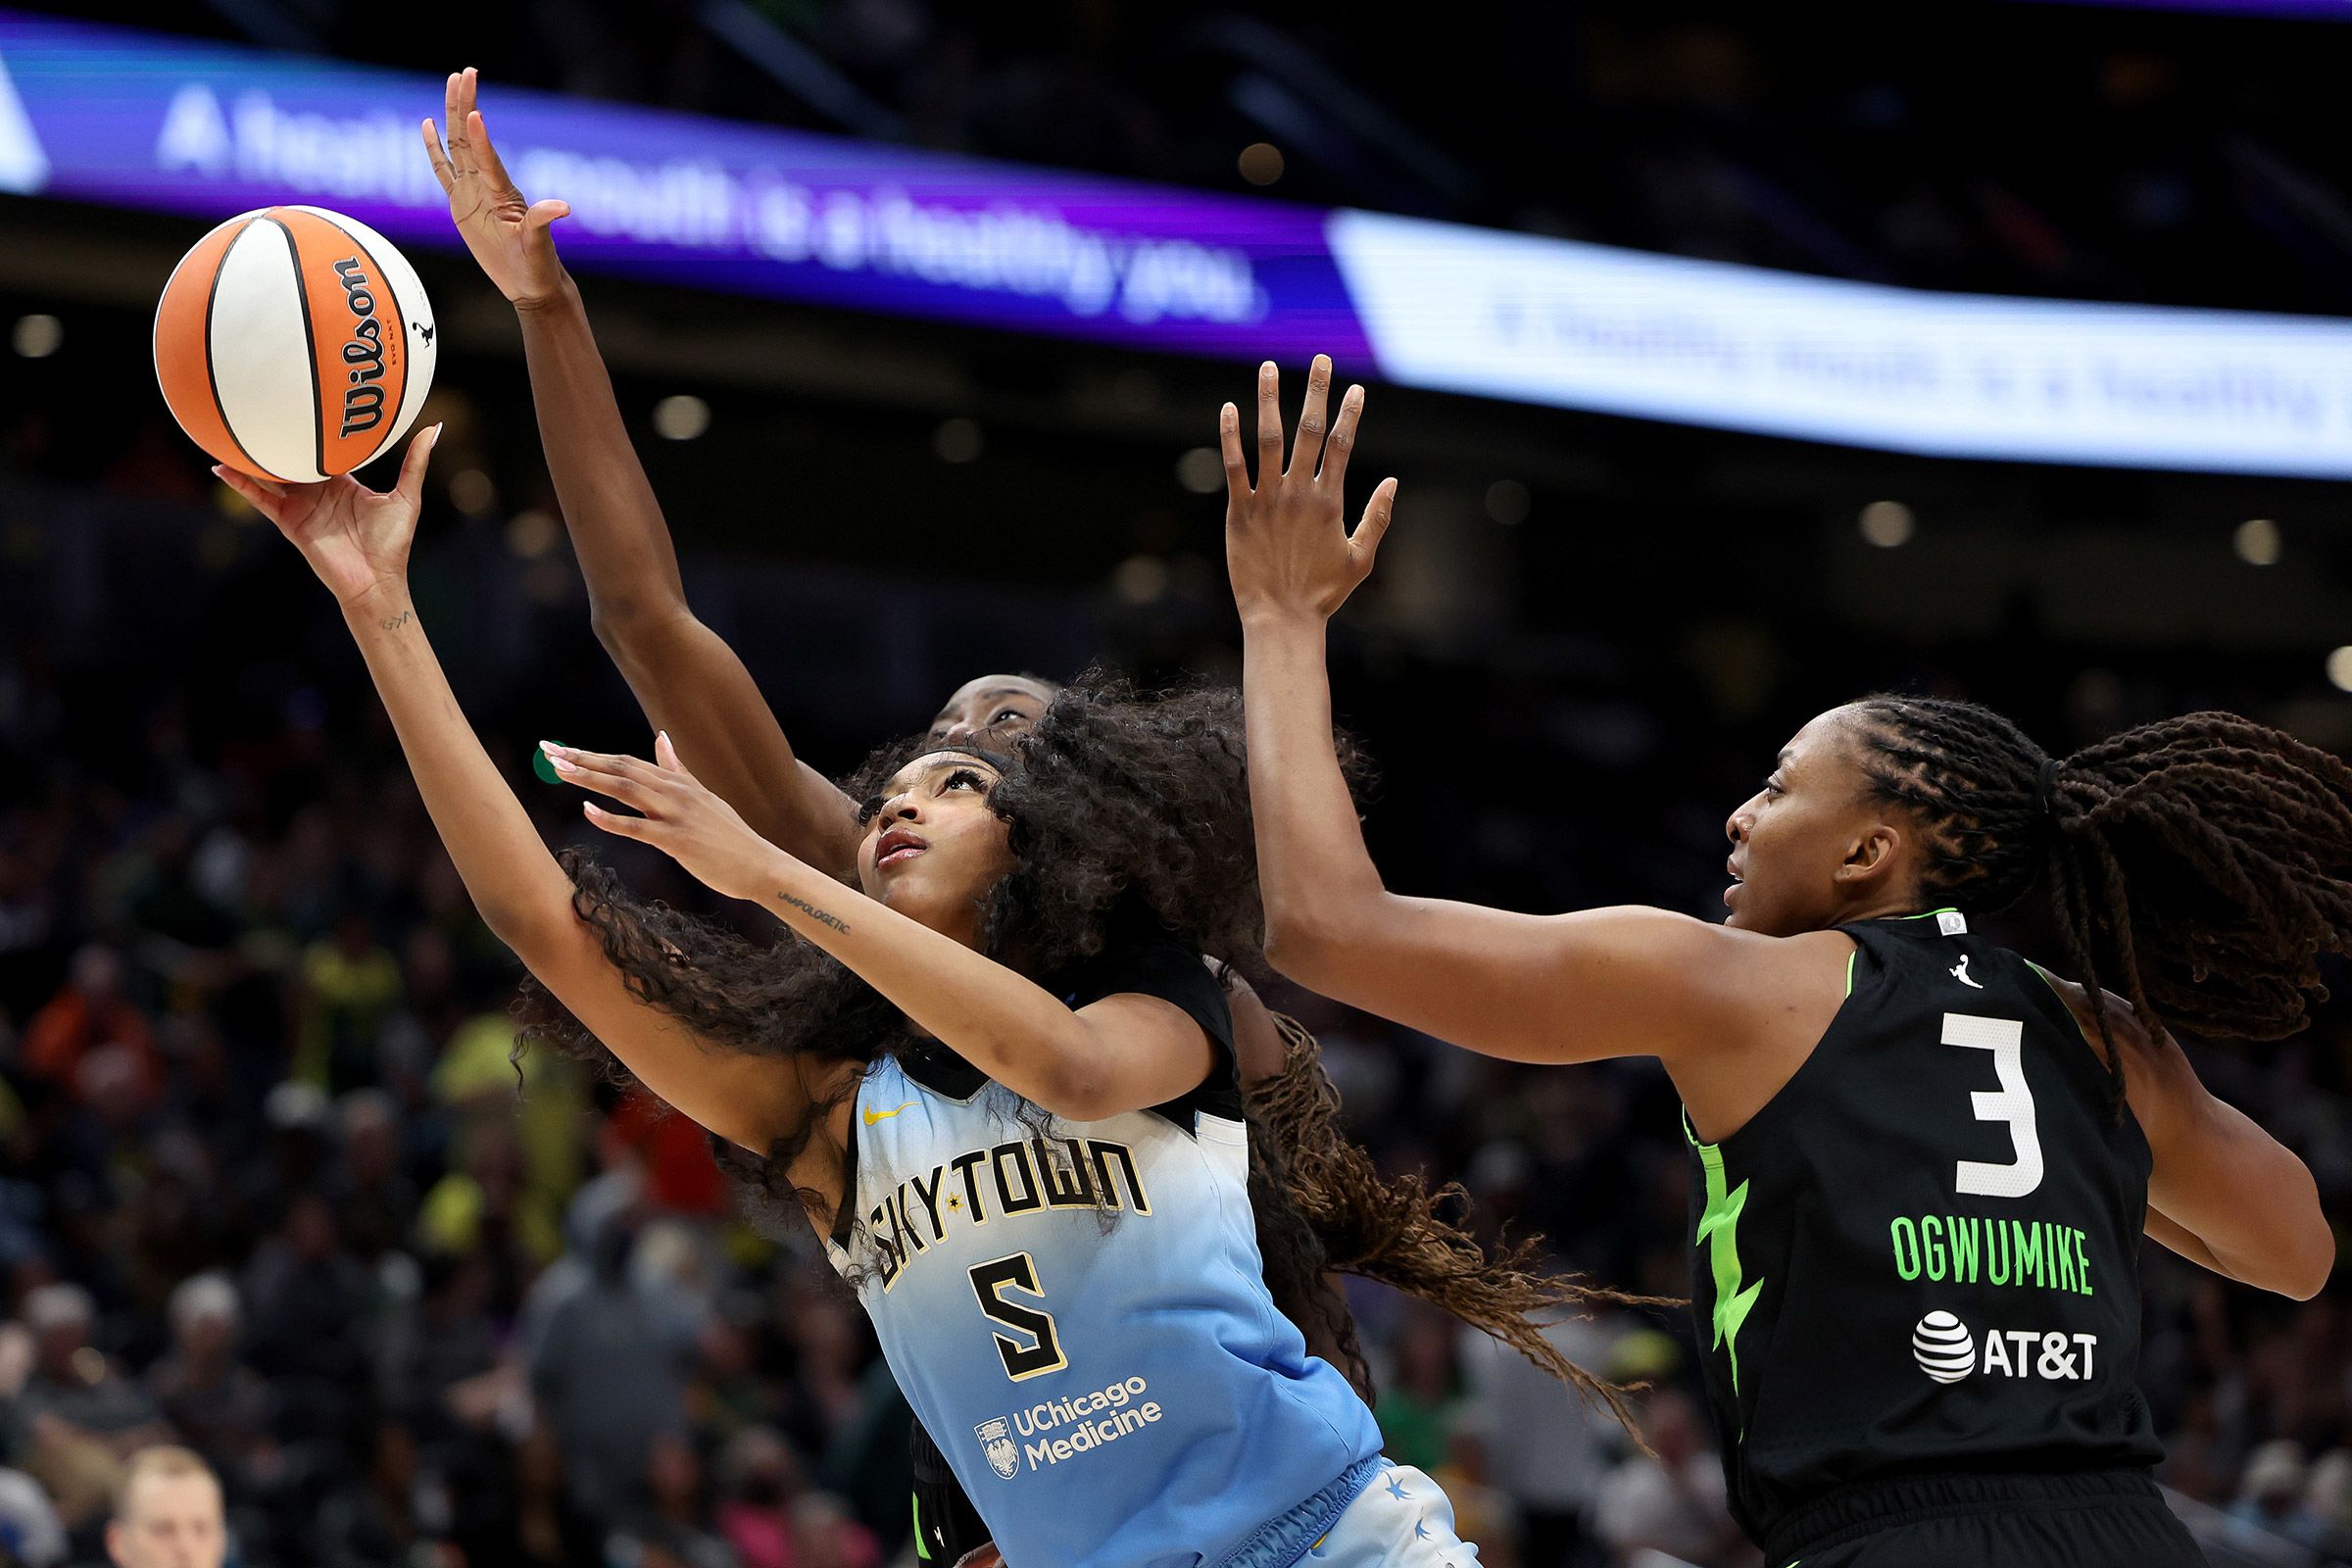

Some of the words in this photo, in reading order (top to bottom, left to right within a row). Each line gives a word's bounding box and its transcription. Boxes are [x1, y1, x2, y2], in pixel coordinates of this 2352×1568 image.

[333, 256, 386, 439] Wilson
[1940, 1012, 2044, 1198] 3
[1890, 1215, 2093, 1296] OGWUMIKE
[966, 1250, 1069, 1383] 5
[1984, 1329, 2097, 1381] AT&T
[1013, 1376, 1147, 1437] UChicago
[1024, 1401, 1162, 1471] Medicine
